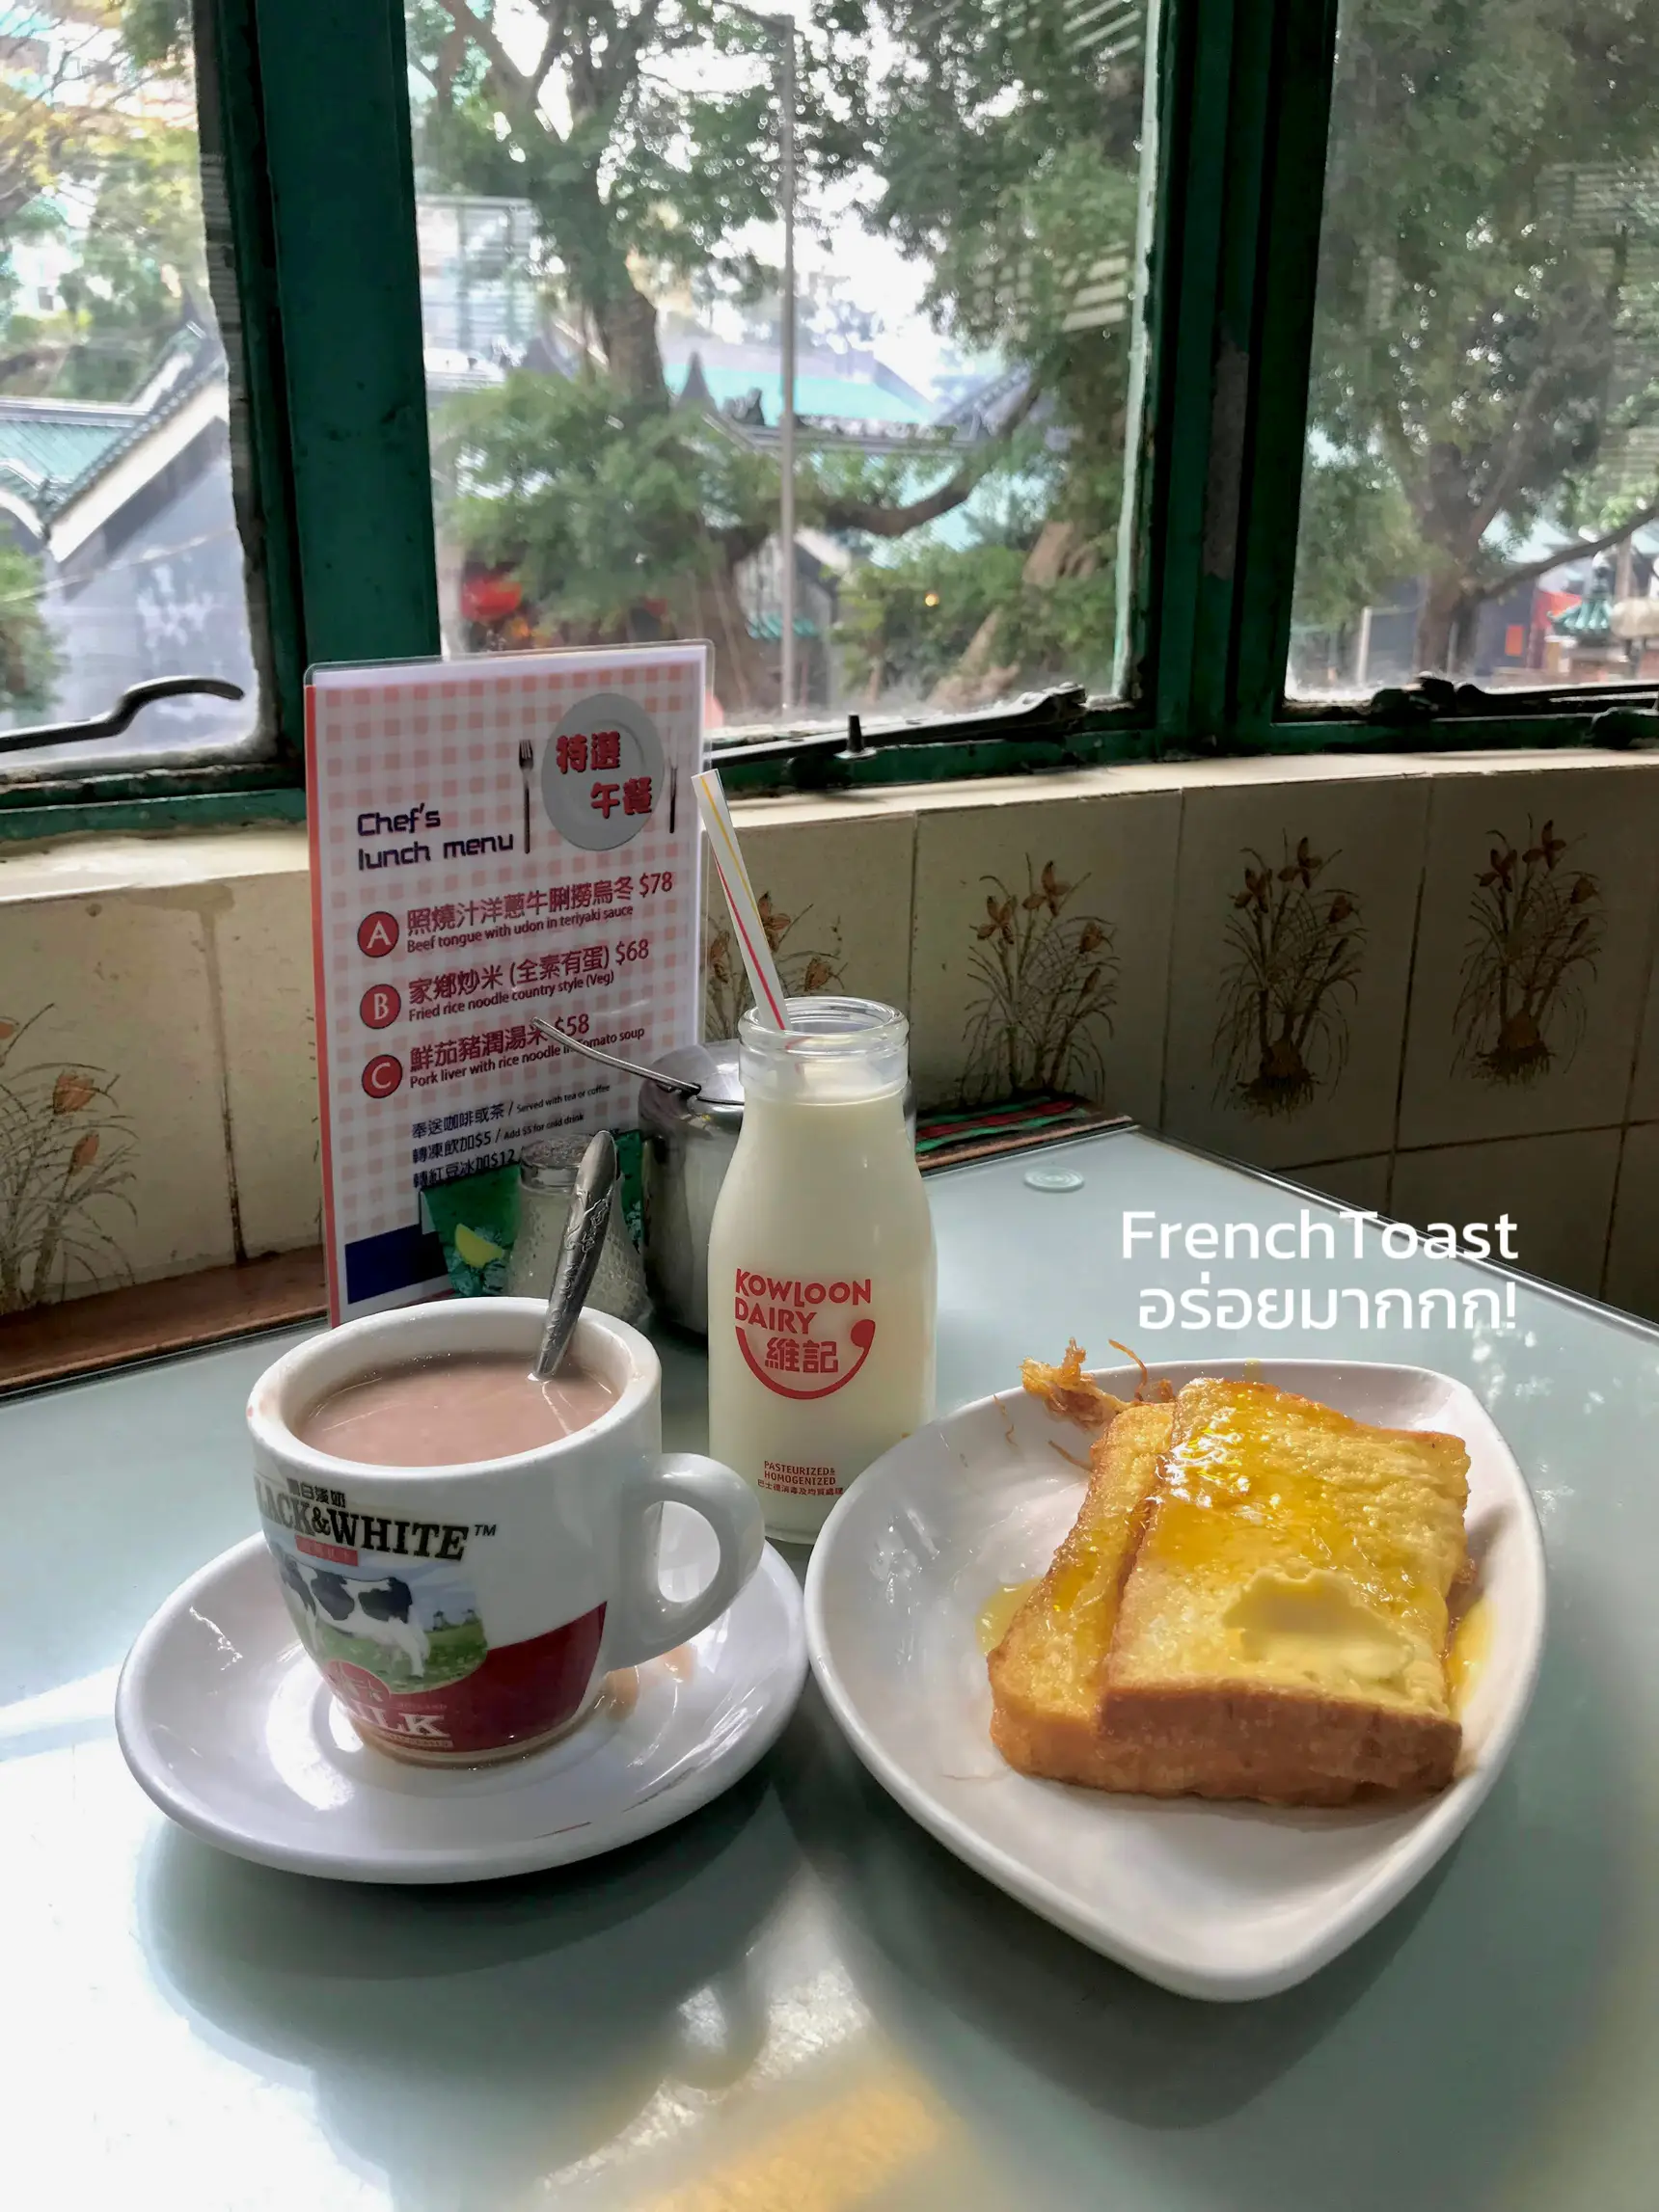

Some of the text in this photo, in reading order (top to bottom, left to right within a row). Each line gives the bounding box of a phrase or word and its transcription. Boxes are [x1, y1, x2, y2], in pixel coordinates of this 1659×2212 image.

[556, 730, 621, 774] 特選
[590, 776, 652, 819] 午餐
[357, 802, 442, 837] Chef's
[358, 833, 514, 871] lunch menu
[639, 871, 673, 898] $78
[367, 920, 392, 949] A
[407, 905, 634, 954] Beef tongue with udon in teriyaki sauce
[509, 945, 610, 986] (全素有蛋)
[614, 938, 649, 965] $68
[373, 992, 390, 1021] B
[408, 969, 614, 1022] Fried rice noodle country style (Veg)
[555, 1012, 590, 1038] $58
[371, 1062, 392, 1090] C
[410, 1071, 439, 1088] Pork
[441, 1066, 467, 1081] liver
[470, 1059, 496, 1075] with
[498, 1055, 520, 1069] rice
[521, 1043, 561, 1062] noodle
[619, 1027, 645, 1041] soup
[516, 1098, 544, 1114] Served
[545, 1094, 562, 1107] with
[563, 1093, 577, 1103] tea
[578, 1090, 586, 1098] or
[587, 1083, 611, 1096] coffee
[503, 1128, 521, 1141] Add
[533, 1122, 545, 1134] for
[735, 1267, 872, 1308] KOWLOON
[734, 1296, 817, 1335] DAIRY
[764, 1336, 839, 1373] 維記
[764, 1470, 836, 1486] HOMOGENIZED
[254, 1477, 470, 1561] LACK&WHITE
